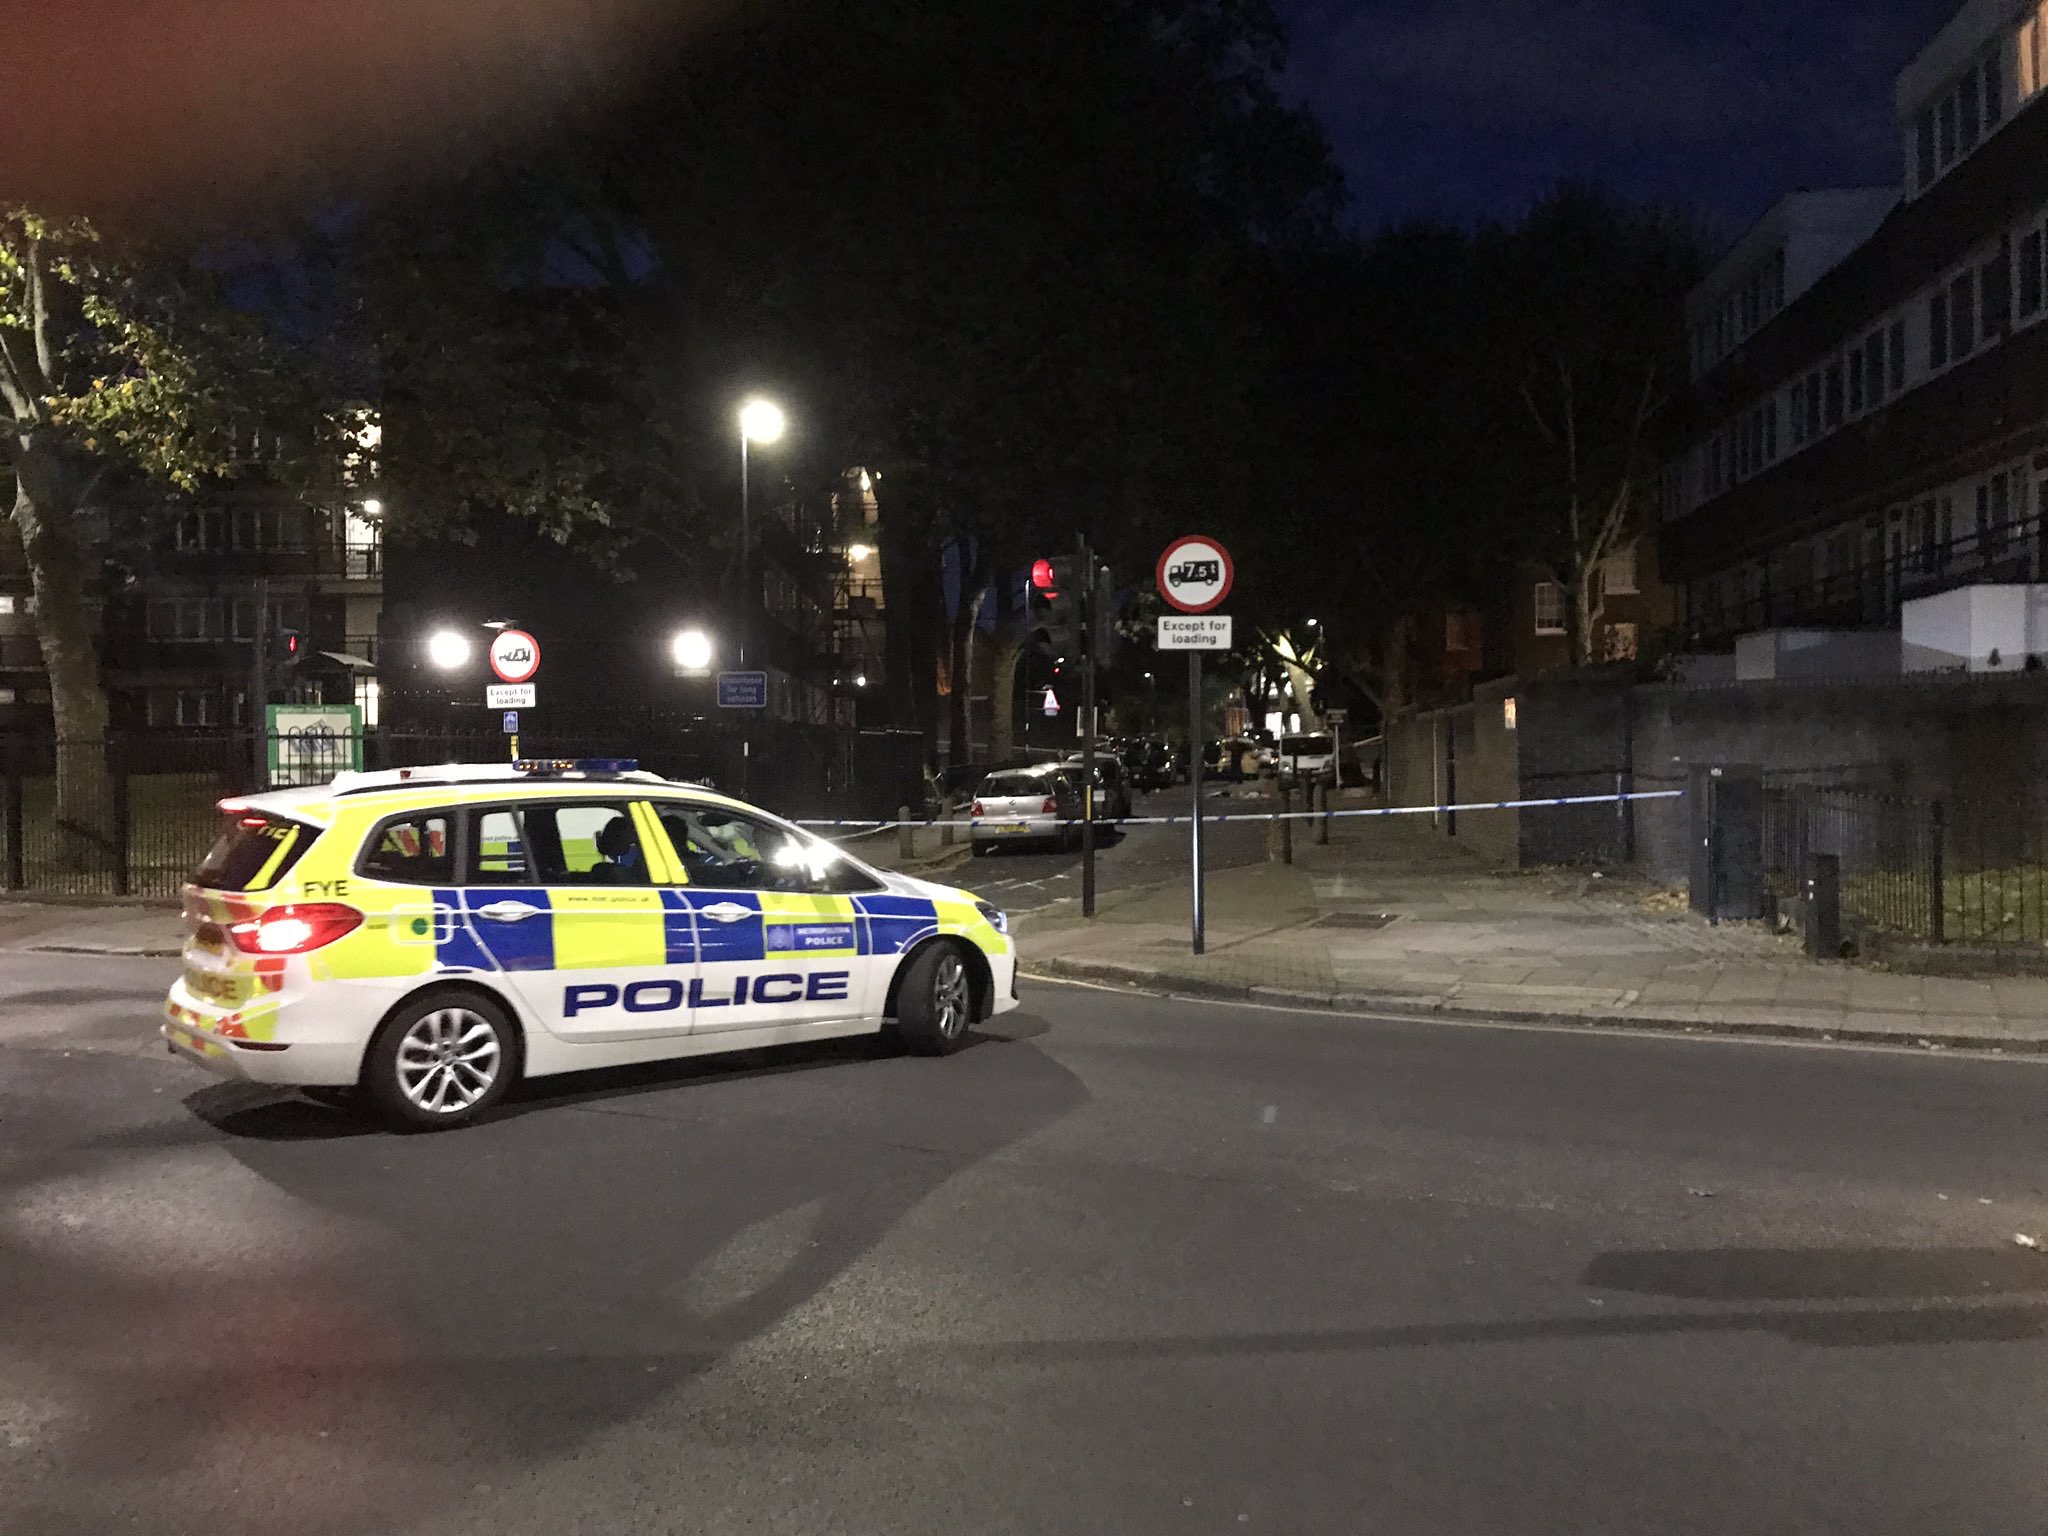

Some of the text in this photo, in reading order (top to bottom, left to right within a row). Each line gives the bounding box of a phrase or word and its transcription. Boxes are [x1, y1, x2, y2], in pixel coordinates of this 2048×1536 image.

[1163, 620, 1227, 632] Except for
[1172, 633, 1217, 645] loading
[490, 688, 517, 696] Except
[496, 697, 526, 705] loading
[303, 879, 350, 898] FYE
[804, 936, 844, 946] POLICE
[563, 970, 850, 1018] POLICE
